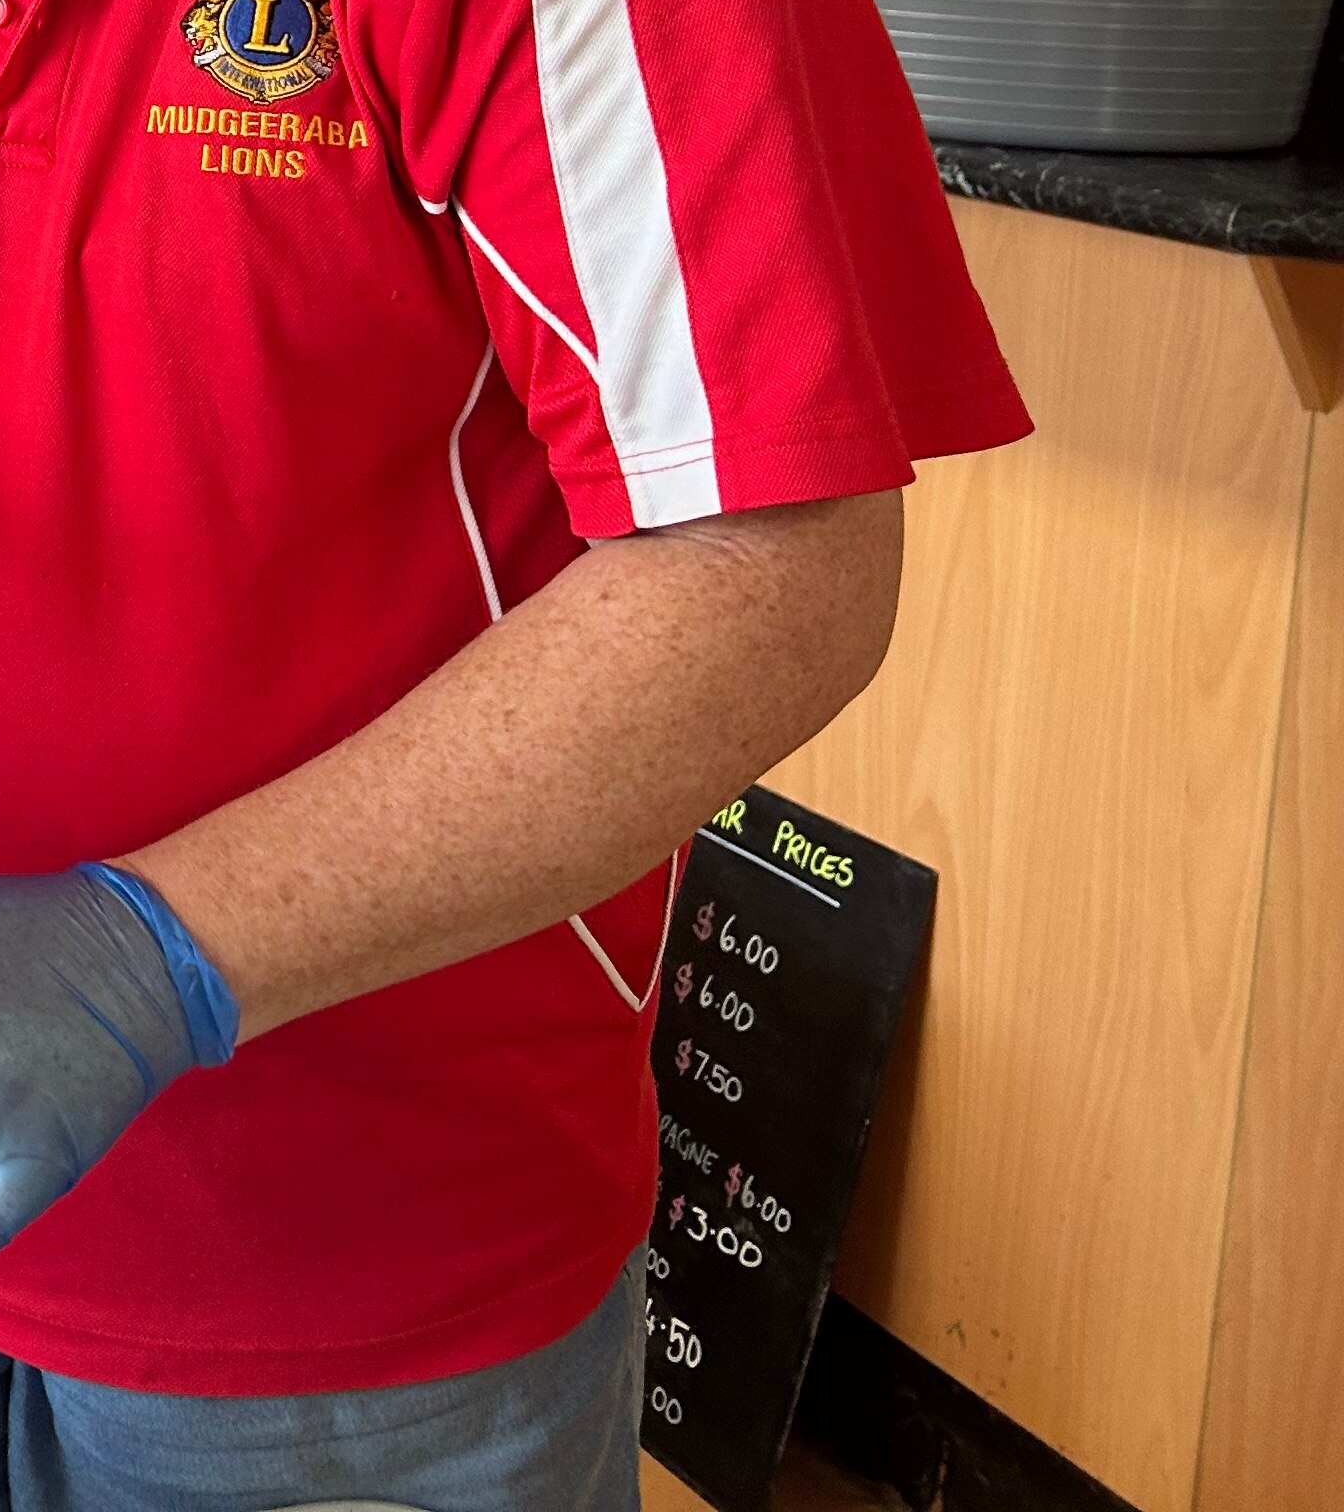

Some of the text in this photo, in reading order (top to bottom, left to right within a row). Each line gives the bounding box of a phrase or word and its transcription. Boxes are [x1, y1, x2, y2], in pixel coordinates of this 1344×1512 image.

[216, 59, 311, 92] INTERNATIONAL
[146, 105, 369, 149] MUDGEERABA
[201, 144, 306, 178] LIONS
[772, 820, 854, 887] PRICES
[675, 1039, 743, 1103] $7.50
[724, 1162, 792, 1233] $6.00
[669, 1194, 763, 1268] $3.00
